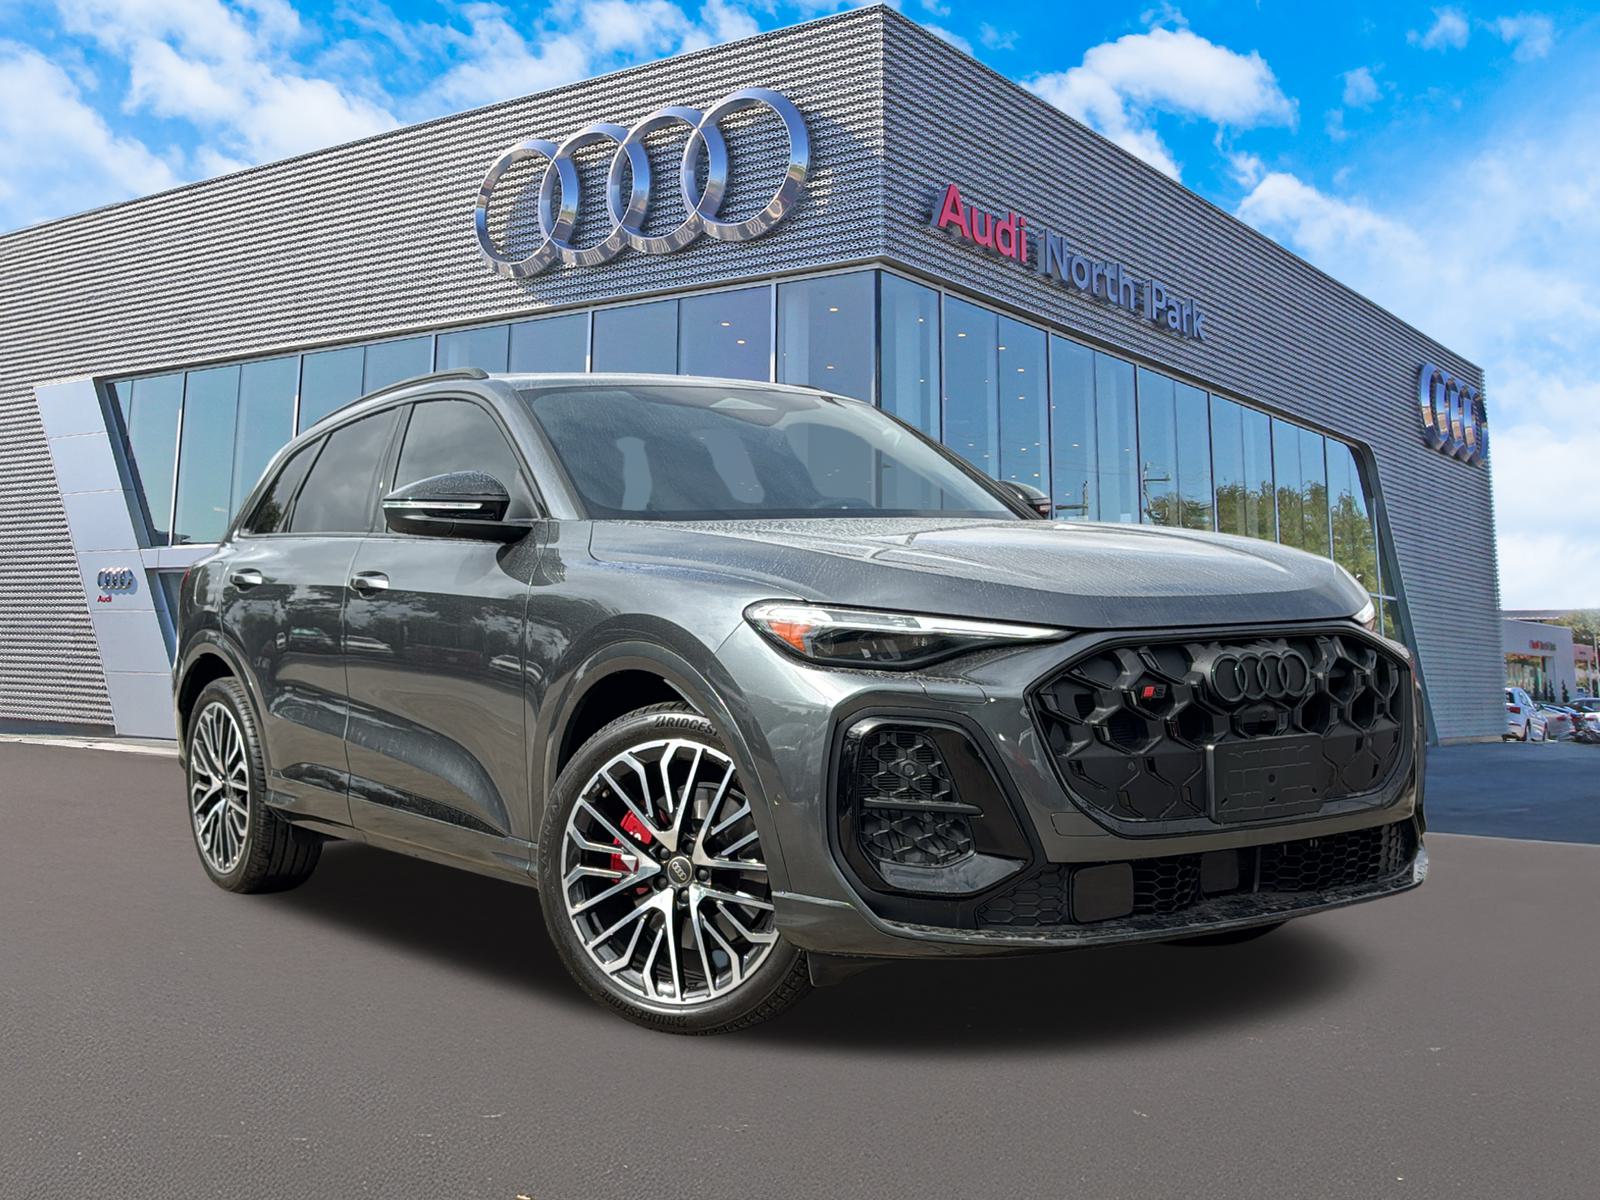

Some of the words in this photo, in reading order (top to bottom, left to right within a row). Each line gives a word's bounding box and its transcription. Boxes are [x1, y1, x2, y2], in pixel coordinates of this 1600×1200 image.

[933, 183, 1028, 263] Audi
[1038, 229, 1137, 313] North
[1144, 279, 1207, 341] Park
[97, 594, 112, 603] Audi
